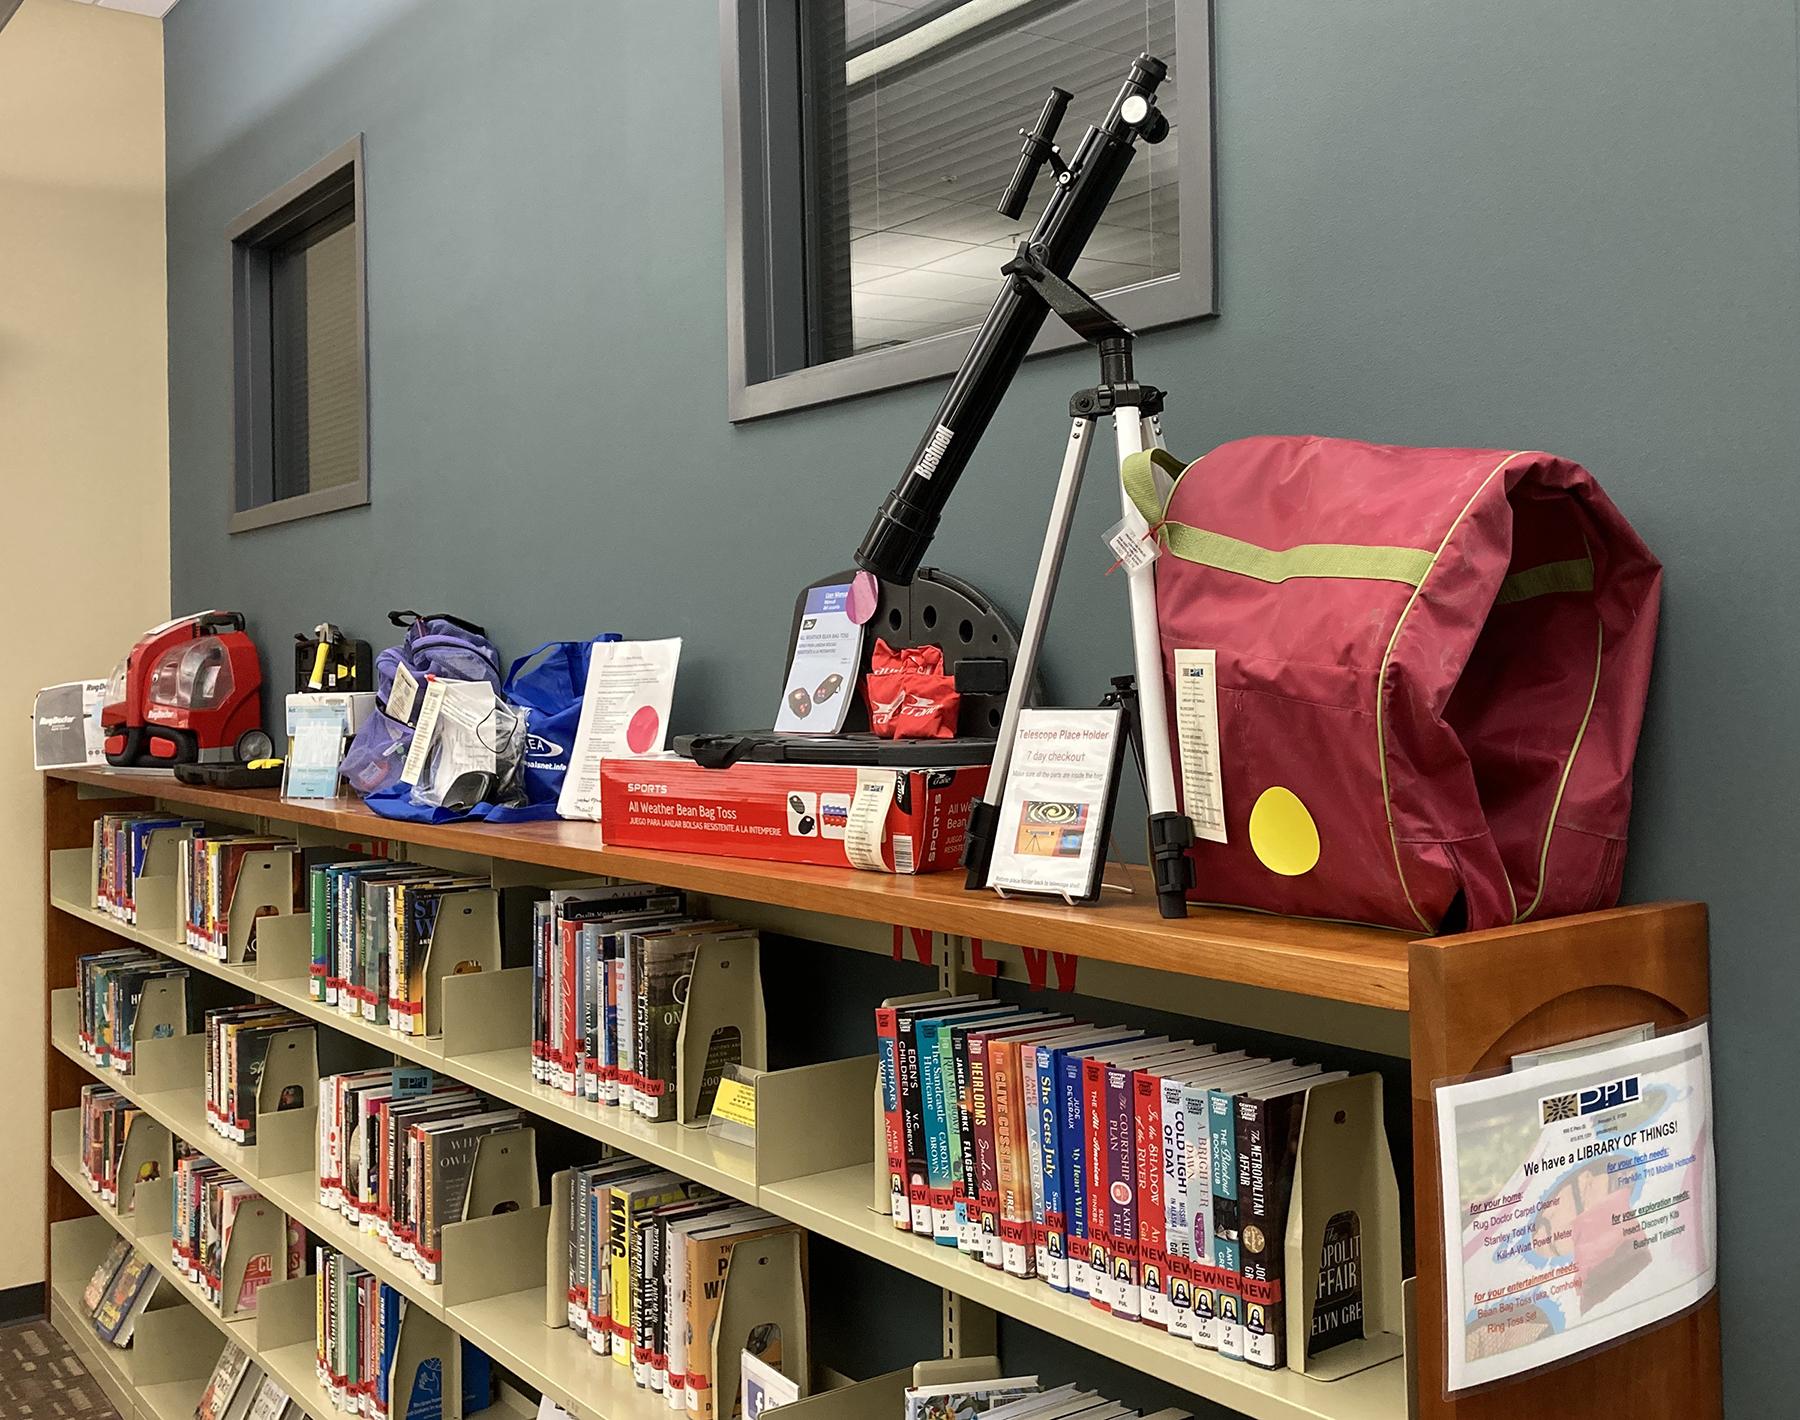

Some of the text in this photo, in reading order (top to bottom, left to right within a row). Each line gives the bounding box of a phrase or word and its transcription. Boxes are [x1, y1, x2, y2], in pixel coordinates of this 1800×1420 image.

[1020, 729, 1109, 741] Telescope Place Holder
[1027, 750, 1086, 763] 7 day checkout
[628, 783, 667, 794] SPORTS
[629, 801, 737, 821] All Weather Bean Bag Toss
[947, 818, 966, 829] Bean
[948, 804, 958, 815] All
[630, 817, 646, 825] JUEGO
[647, 818, 661, 826] PARA
[661, 819, 682, 828] LANZAR
[683, 821, 703, 830] BOLSAS
[704, 822, 735, 832] RESISTENTE
[749, 826, 782, 836] INTEMPERIE
[928, 794, 941, 862] SPORTS
[944, 844, 964, 853] RESISTE
[886, 1040, 897, 1110] POTIPHAR'S
[898, 1041, 909, 1096] CHILDREN
[908, 1048, 918, 1089] EDEN'S
[923, 1056, 933, 1110] Hurricane
[932, 1043, 946, 1123] The Sandcastle
[956, 1057, 965, 1085] JAMES
[971, 1062, 986, 1126] HEIRLOOMS
[1025, 1076, 1033, 1108] DAILEY
[1066, 1086, 1074, 1129] DEVERAUX
[960, 1104, 969, 1132] BURKE
[995, 1072, 1012, 1182] CLIVE CUSSLER
[1041, 1076, 1056, 1179] She Gets July
[1135, 1115, 1145, 1130] of
[1148, 1125, 1157, 1140] the
[885, 1118, 893, 1154] ANDRE
[1110, 1120, 1118, 1151] PLAN
[1120, 1113, 1130, 1181] COURTSHIP
[1524, 1162, 1540, 1176] We
[1542, 1157, 1566, 1170] have
[1568, 1154, 1575, 1162] a
[1577, 1136, 1621, 1161] LIBRARY
[1623, 1132, 1637, 1147] OF
[1640, 1121, 1678, 1142] THINGS!
[930, 1137, 939, 1174] BROWN
[939, 1132, 949, 1179] CAROLYN
[963, 1141, 973, 1172] FLAGS
[1030, 1140, 1040, 1189] CALDER
[1072, 1148, 1080, 1161] My
[1164, 1125, 1174, 1179] OF DAY
[1175, 1111, 1188, 1196] COLD LIGHT
[1186, 1144, 1195, 1179] DAWN
[1197, 1122, 1208, 1208] A BRIGHTER
[1607, 1163, 1616, 1172] for
[1618, 1159, 1633, 1170] your
[1634, 1154, 1647, 1164] tech
[1138, 1148, 1146, 1189] RIVER
[1148, 1143, 1160, 1206] SHADOW
[1221, 1148, 1231, 1195] Blackout
[1240, 1152, 1251, 1187] AFFAIR
[1251, 1130, 1265, 1217] The METROPOLITAN
[1617, 1172, 1642, 1186] Franklin
[1643, 1167, 1655, 1178] T10
[1656, 1162, 1674, 1174] Mobile
[1006, 1190, 1014, 1212] FIRE
[1179, 1202, 1187, 1228] MISSING
[1470, 1192, 1523, 1213] for your home:
[1473, 1197, 1560, 1231] Rug Doctor Carpet Cleaner
[1612, 1214, 1621, 1223] for
[1622, 1209, 1637, 1220] your
[1638, 1197, 1671, 1214] exploration
[611, 1195, 626, 1258] KING
[1002, 1227, 1022, 1240] NEW
[1484, 1223, 1536, 1247] Stanley Tool Kit
[1623, 1210, 1680, 1236] Insect Discovery Kits
[1633, 1224, 1685, 1250] Bushnell Telescope
[1110, 1241, 1136, 1256] NEW
[1142, 1247, 1167, 1260] NEW
[1497, 1230, 1572, 1261] Kill-A-Watt Power Meter
[1243, 1283, 1272, 1299] NEW
[1474, 1262, 1580, 1302] for your entertainment needs:
[1478, 1307, 1498, 1319] Bean
[1499, 1302, 1514, 1314] Bag
[1516, 1297, 1532, 1307] Toss
[1487, 1311, 1537, 1334] Ring Toss Set
[1251, 1348, 1261, 1356] GRE
